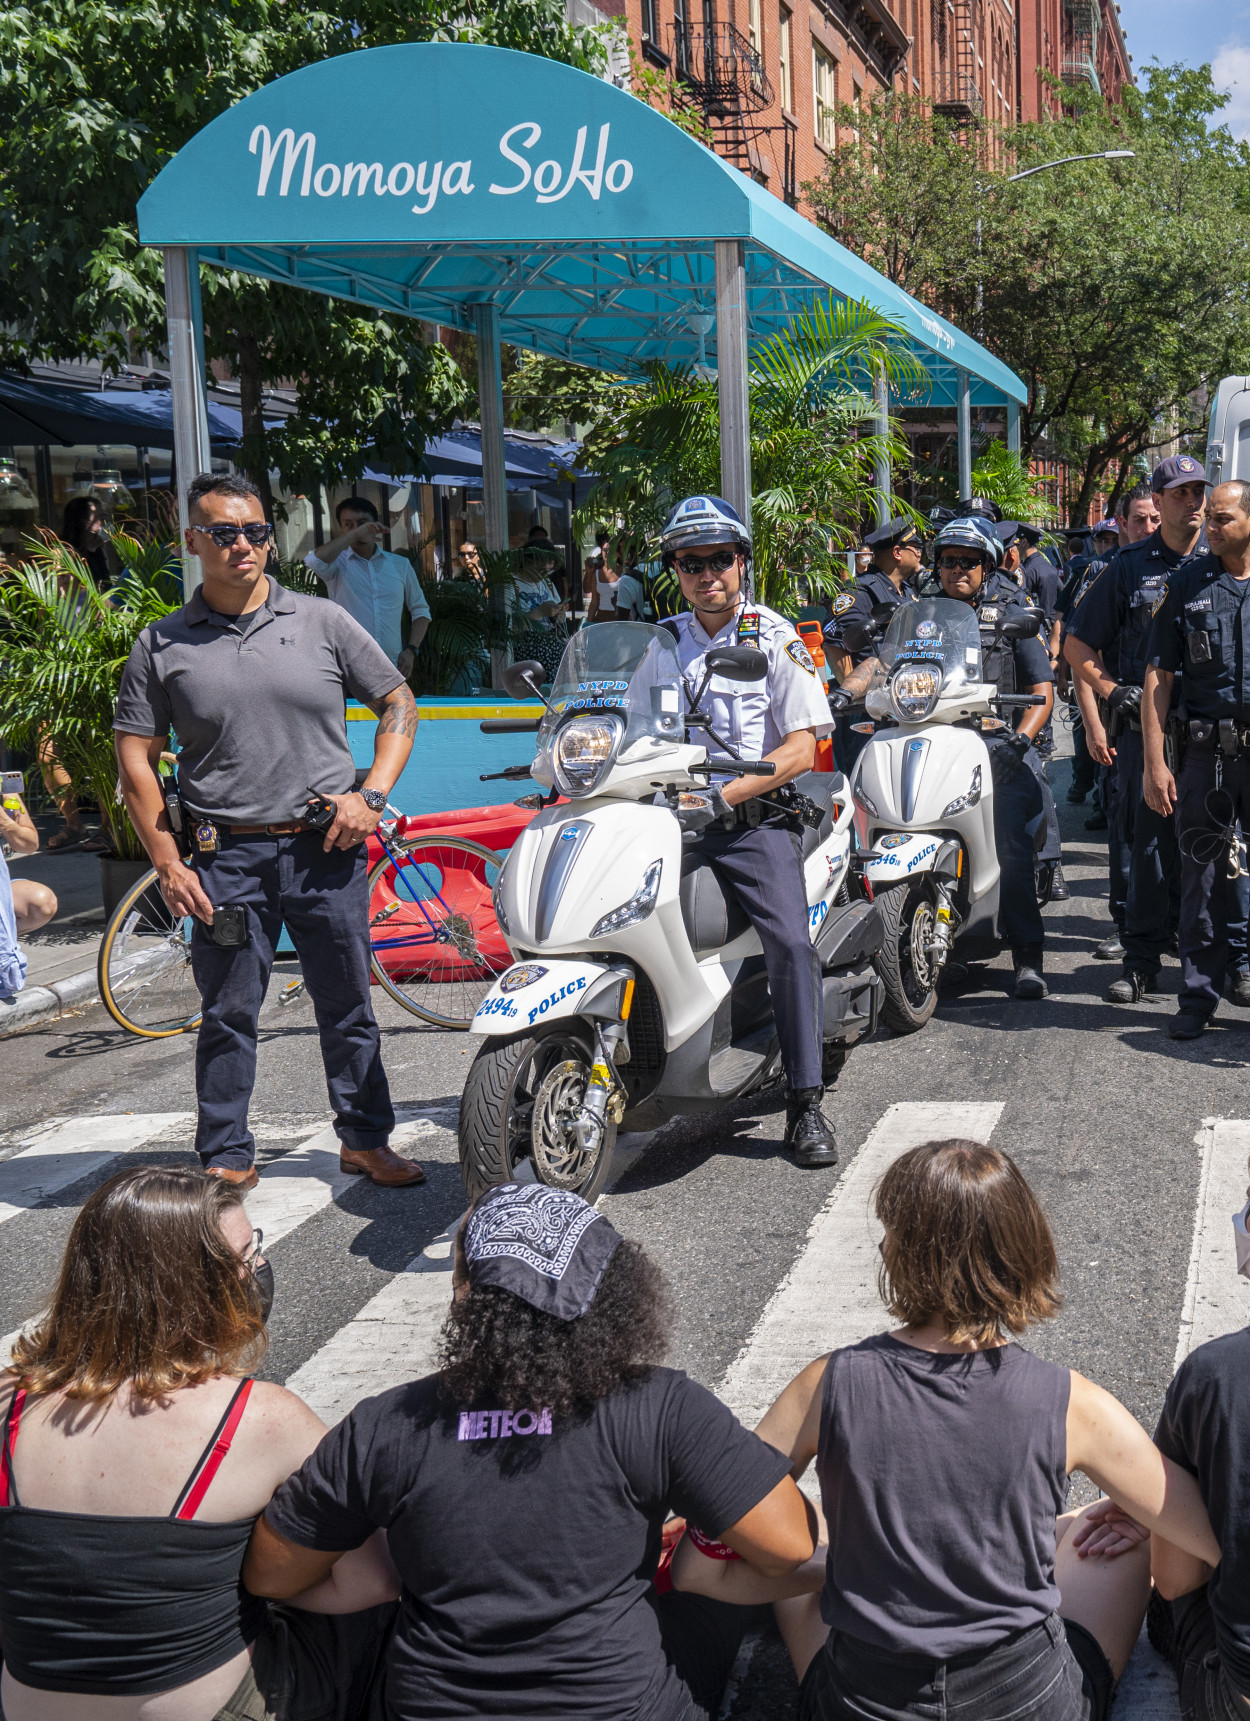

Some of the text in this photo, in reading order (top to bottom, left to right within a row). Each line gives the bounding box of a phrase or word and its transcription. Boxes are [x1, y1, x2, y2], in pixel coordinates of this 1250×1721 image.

[248, 121, 634, 215] Momoya SoHo
[904, 639, 943, 648] NYPD
[895, 651, 945, 660] POLICE
[576, 680, 629, 693] NYPD
[563, 697, 631, 711] POLICE
[906, 843, 937, 873] POLICE
[476, 997, 514, 1017] 2494
[527, 976, 586, 1026] POLICE
[457, 1406, 553, 1442] METEOR
